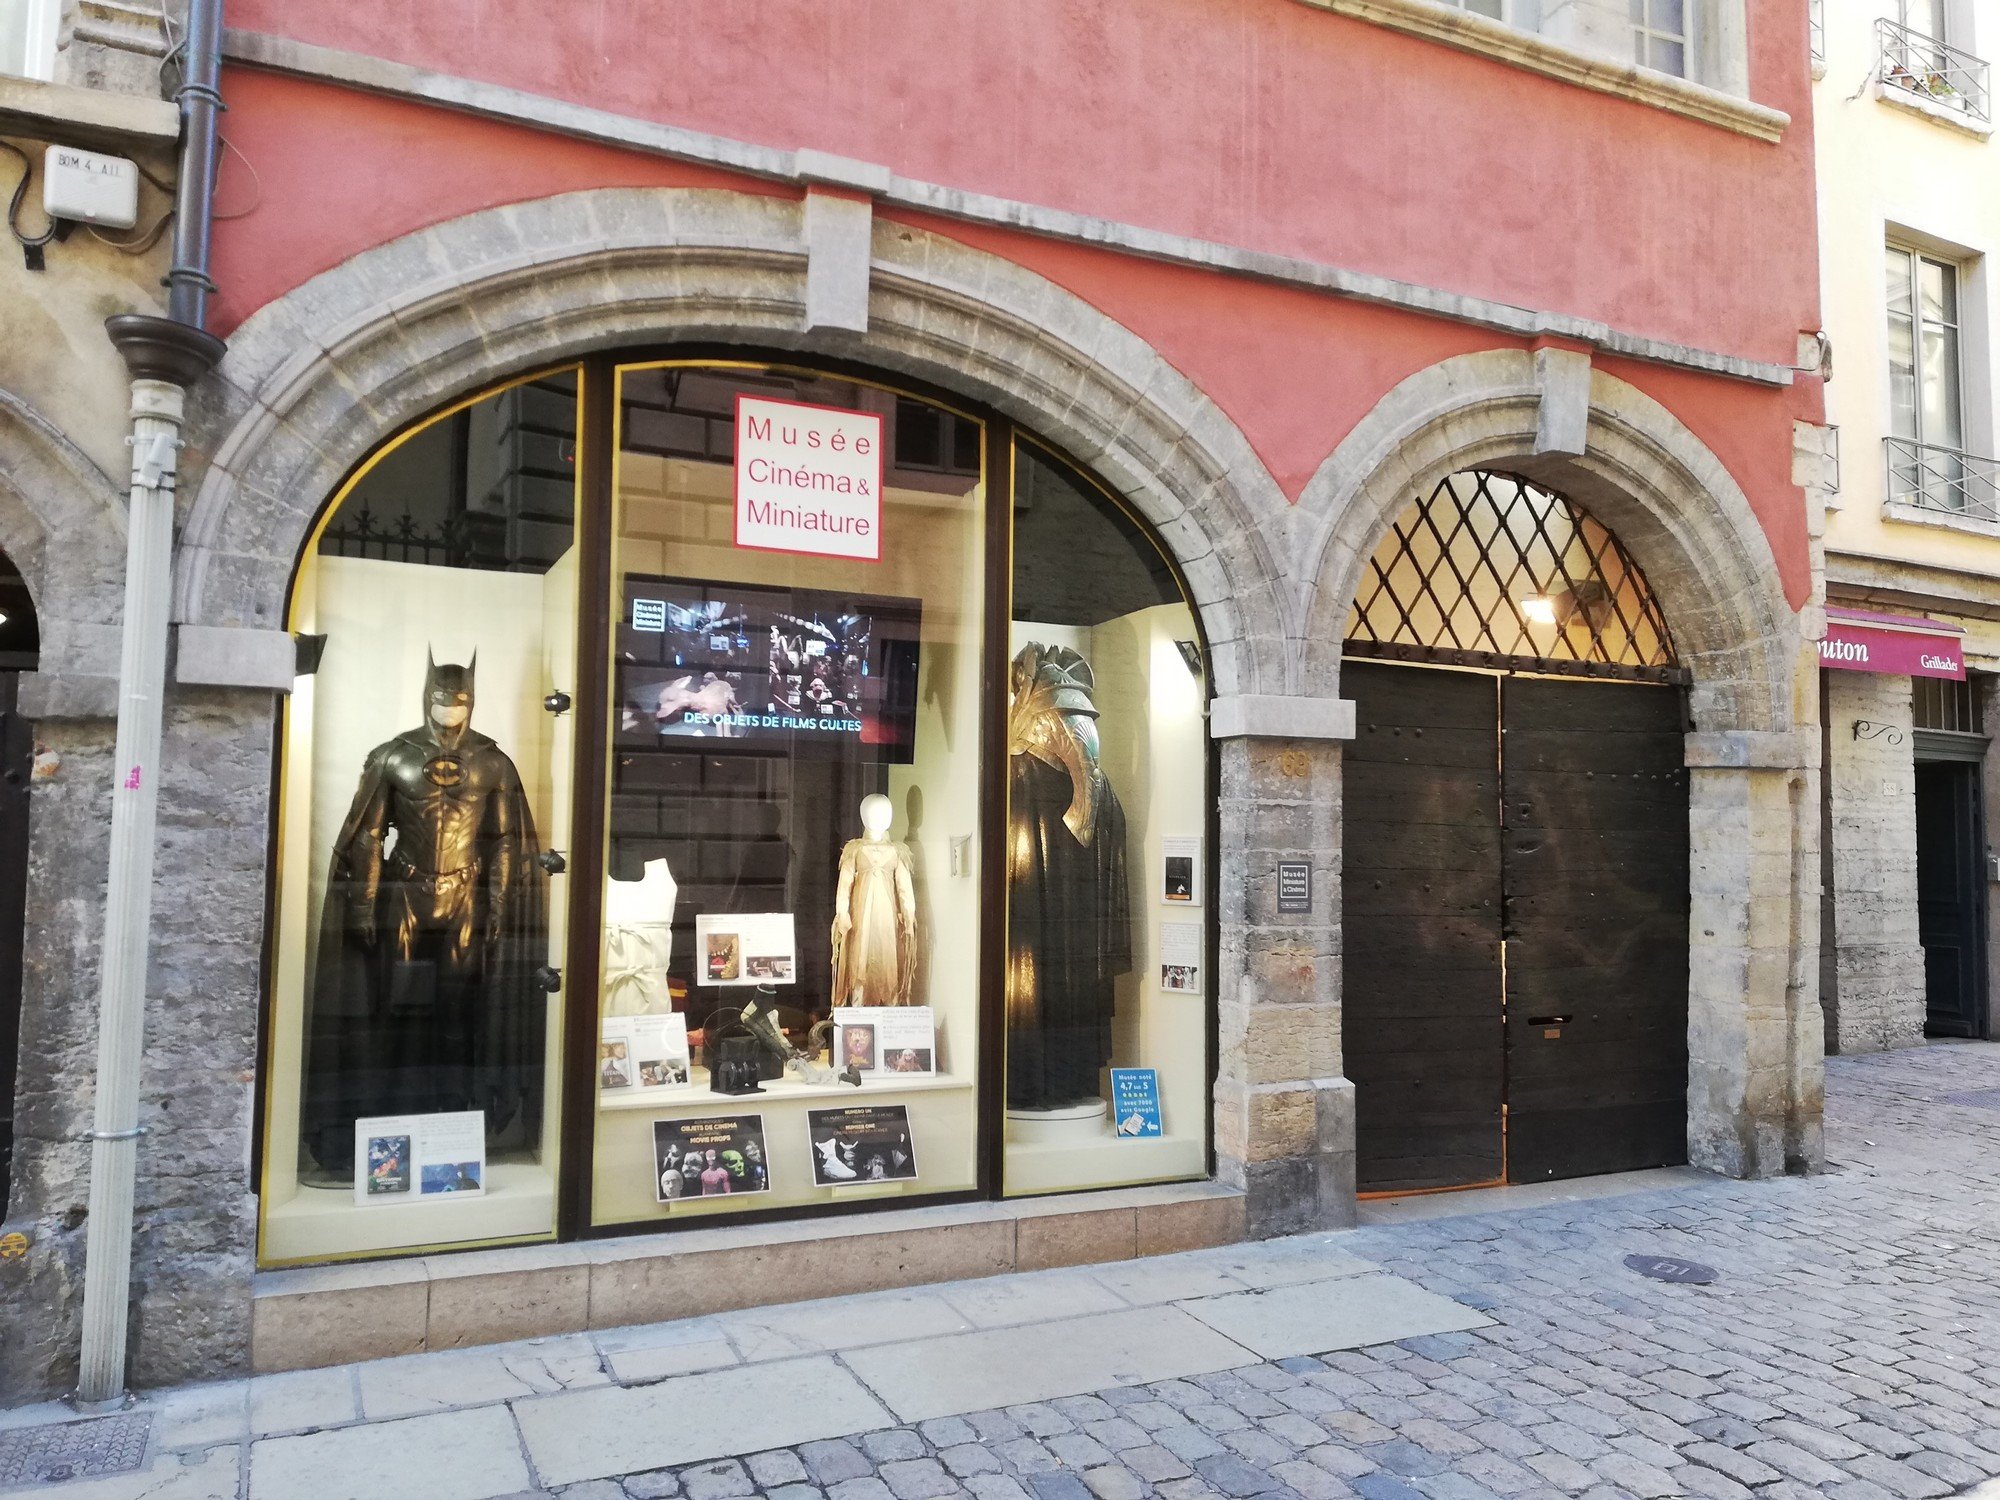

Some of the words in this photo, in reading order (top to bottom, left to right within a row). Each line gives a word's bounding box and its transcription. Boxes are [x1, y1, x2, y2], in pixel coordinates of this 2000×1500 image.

[748, 415, 871, 455] Musée
[748, 458, 851, 494] Cinéma
[857, 478, 870, 496] &
[747, 499, 870, 536] Miniature
[684, 712, 710, 724] DES
[712, 713, 760, 727] OBJETS
[762, 716, 780, 728] DE
[782, 717, 817, 730] FILMS
[819, 719, 863, 732] CULTES
